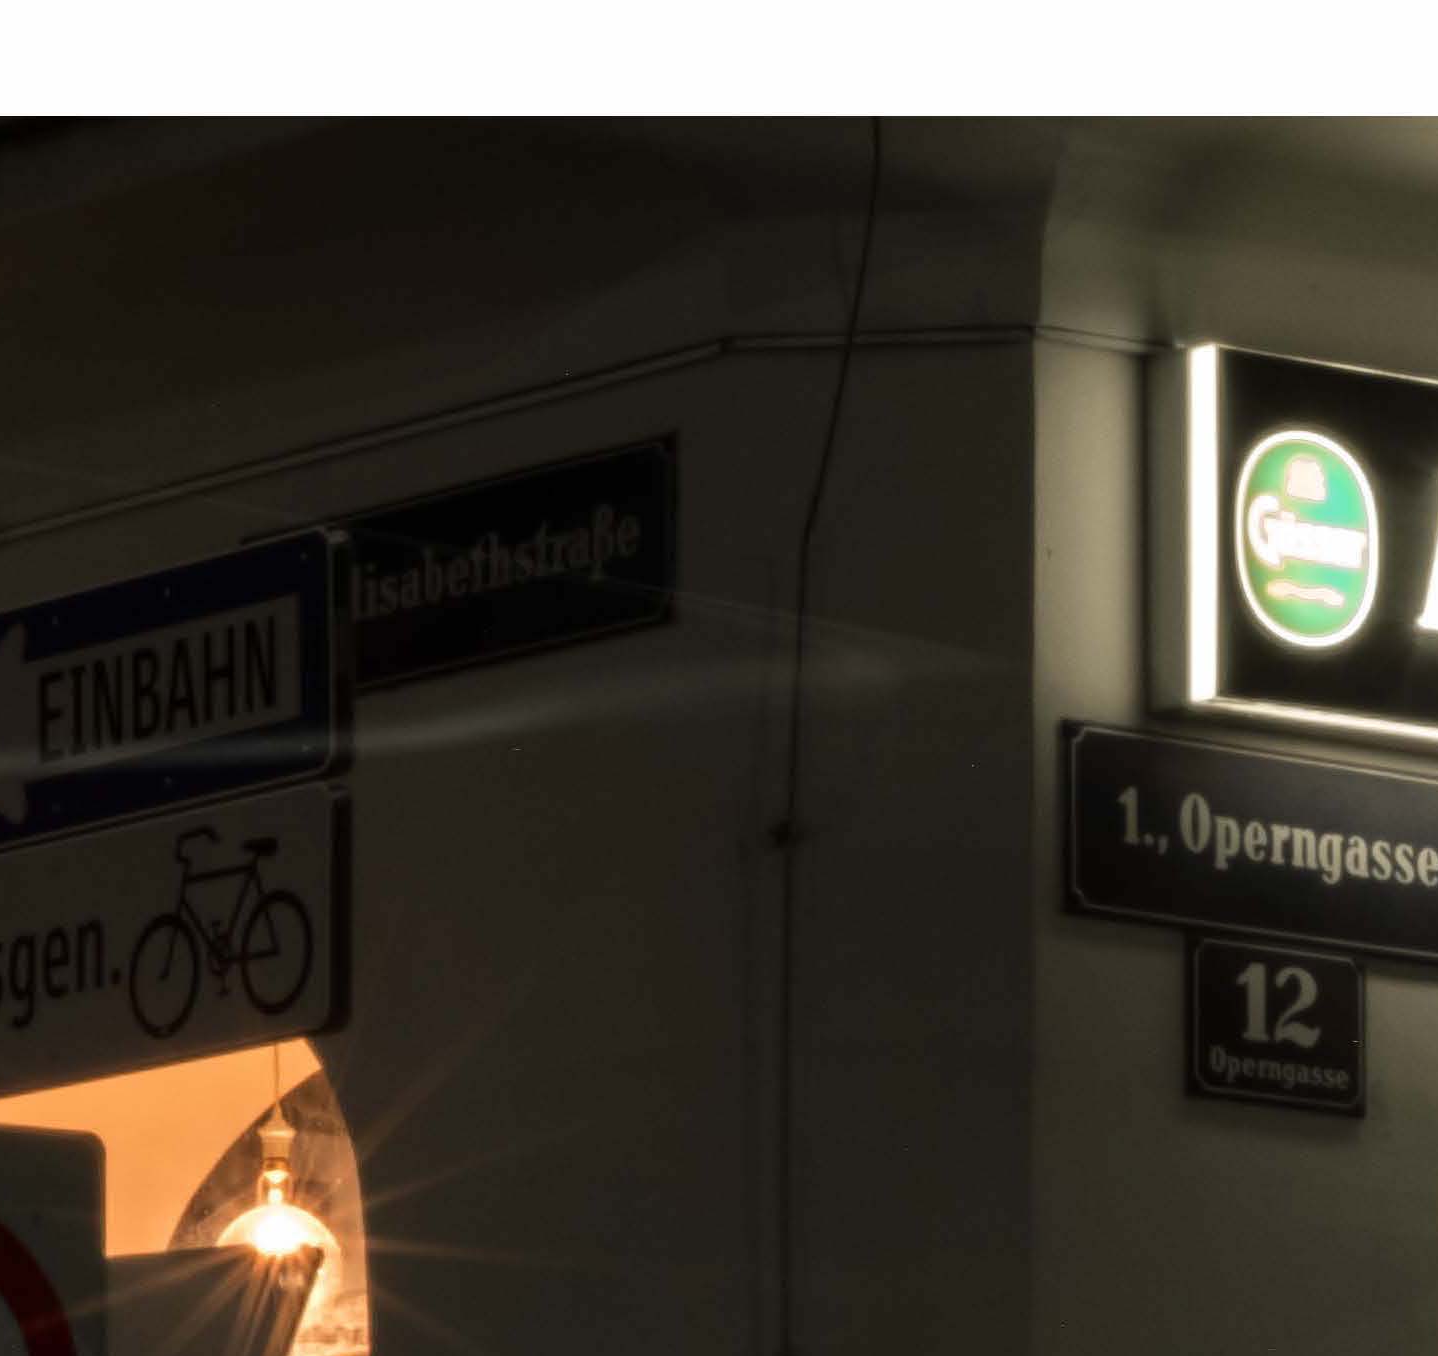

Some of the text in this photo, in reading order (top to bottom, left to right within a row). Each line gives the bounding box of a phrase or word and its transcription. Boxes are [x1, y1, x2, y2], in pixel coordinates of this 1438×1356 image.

[349, 502, 642, 622] lisabethstraße
[38, 614, 277, 764] EINBAHN
[1236, 961, 1321, 1049] 12
[1209, 1044, 1350, 1089] Operngasse
